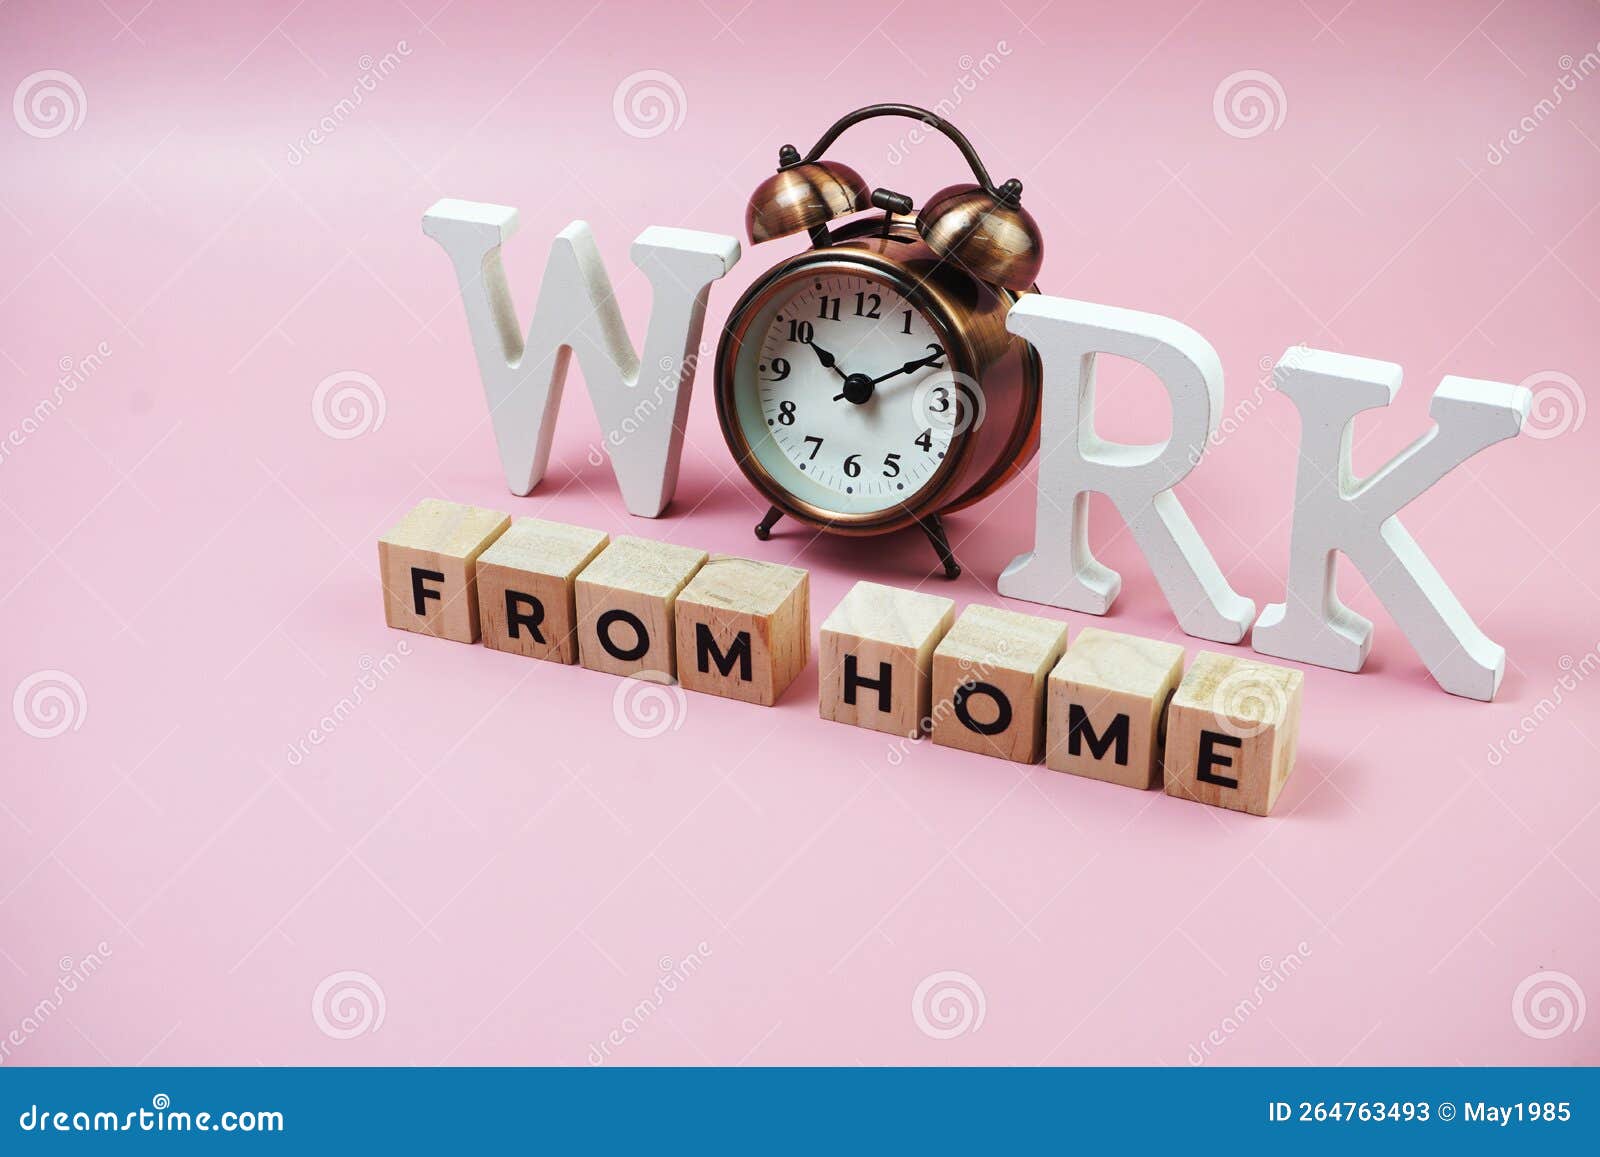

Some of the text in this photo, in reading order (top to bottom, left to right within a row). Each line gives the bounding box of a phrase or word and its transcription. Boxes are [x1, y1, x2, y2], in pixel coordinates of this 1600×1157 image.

[816, 295, 841, 321] 11
[853, 291, 882, 319] 12
[786, 318, 814, 345] 10
[900, 309, 913, 335] 1
[925, 343, 945, 369] 2
[770, 357, 791, 382] 9
[777, 400, 797, 426] 8
[928, 387, 950, 413] 3
[804, 435, 824, 460] 7
[914, 427, 933, 452] 4
[843, 454, 863, 478] 6
[882, 452, 902, 478] 5
[410, 567, 1243, 790] FROM HOME
